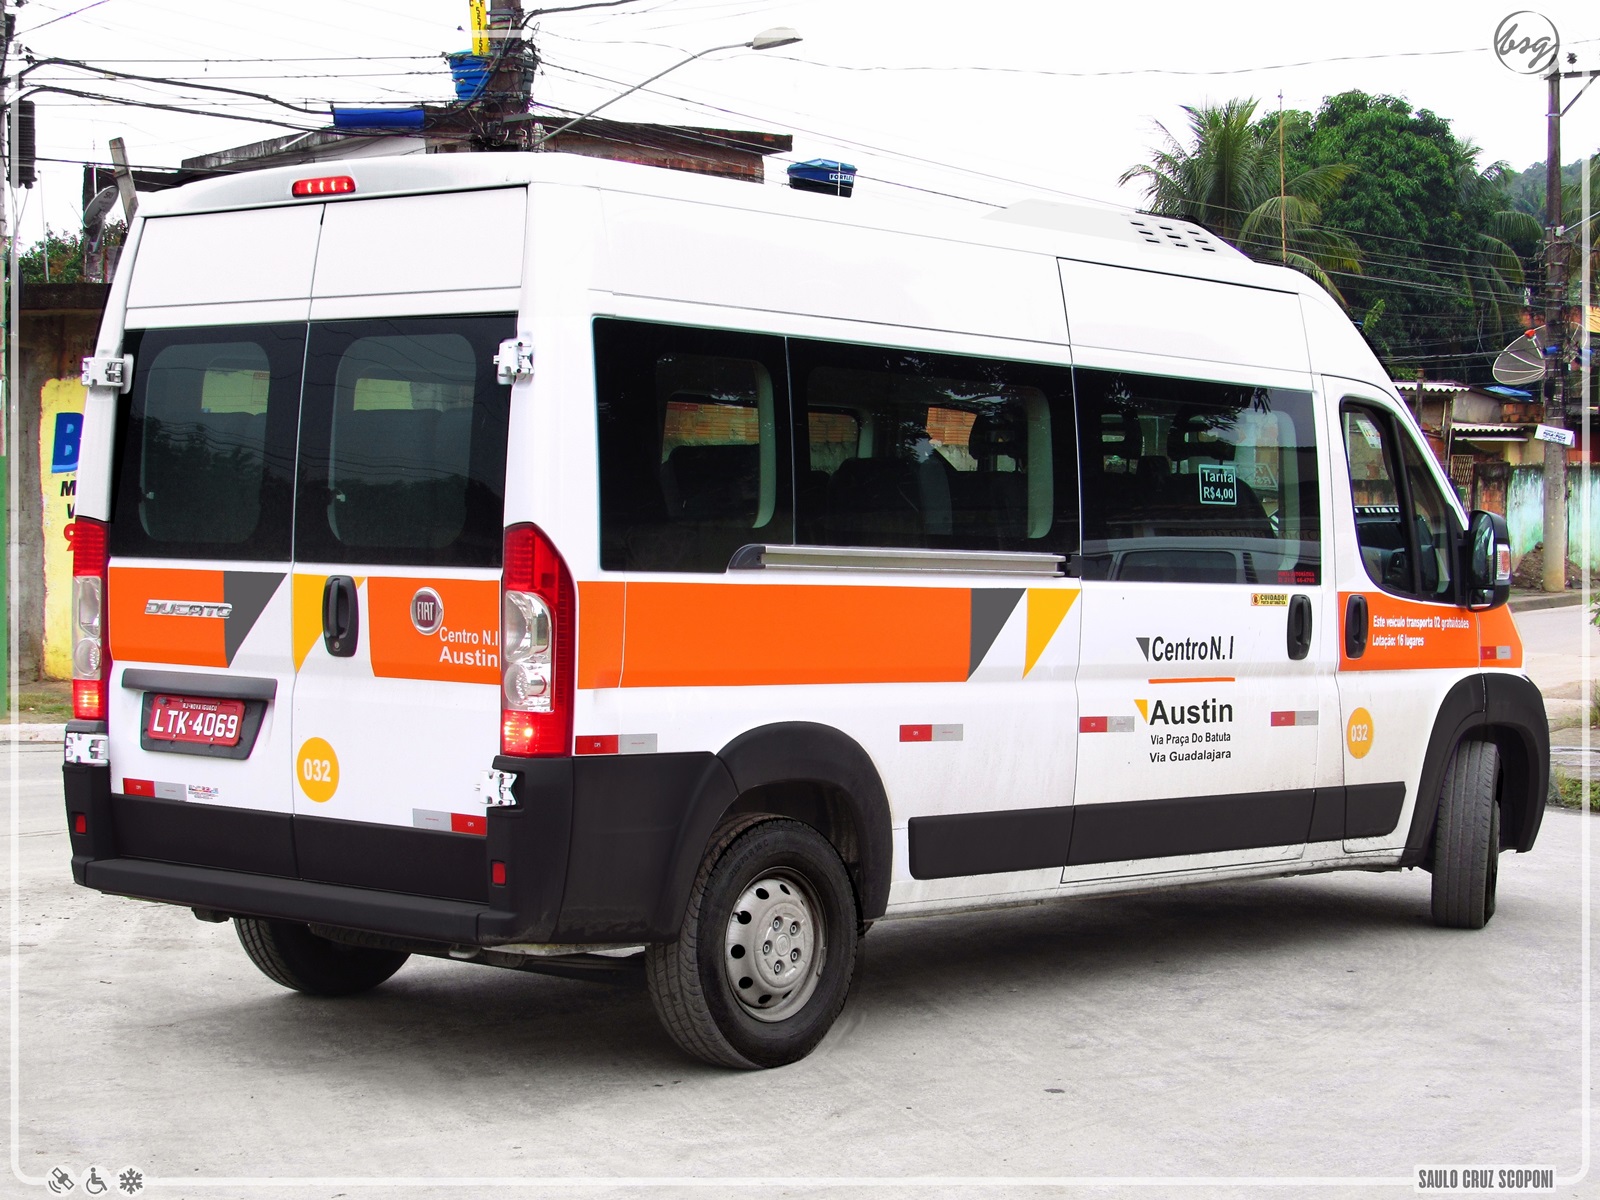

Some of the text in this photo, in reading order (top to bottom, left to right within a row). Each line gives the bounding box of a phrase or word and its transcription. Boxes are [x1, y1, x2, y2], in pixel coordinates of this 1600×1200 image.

[1203, 469, 1234, 483] Tarifa
[1203, 486, 1234, 501] R$4,00
[144, 599, 233, 619] DUCATO
[417, 601, 435, 621] FIAT
[1373, 615, 1386, 628] Este
[1406, 615, 1433, 630] transporta
[1433, 616, 1441, 628] 02
[439, 626, 479, 645] Centro
[1397, 634, 1404, 646] 16
[1404, 634, 1425, 649] lugares
[439, 646, 499, 667] Austin
[1149, 698, 1233, 726] Austin
[1150, 732, 1231, 746] Via Praça Do Batuta
[1351, 724, 1368, 742] 032
[1149, 750, 1232, 763] Via Guadalajara
[303, 758, 331, 782] 032
